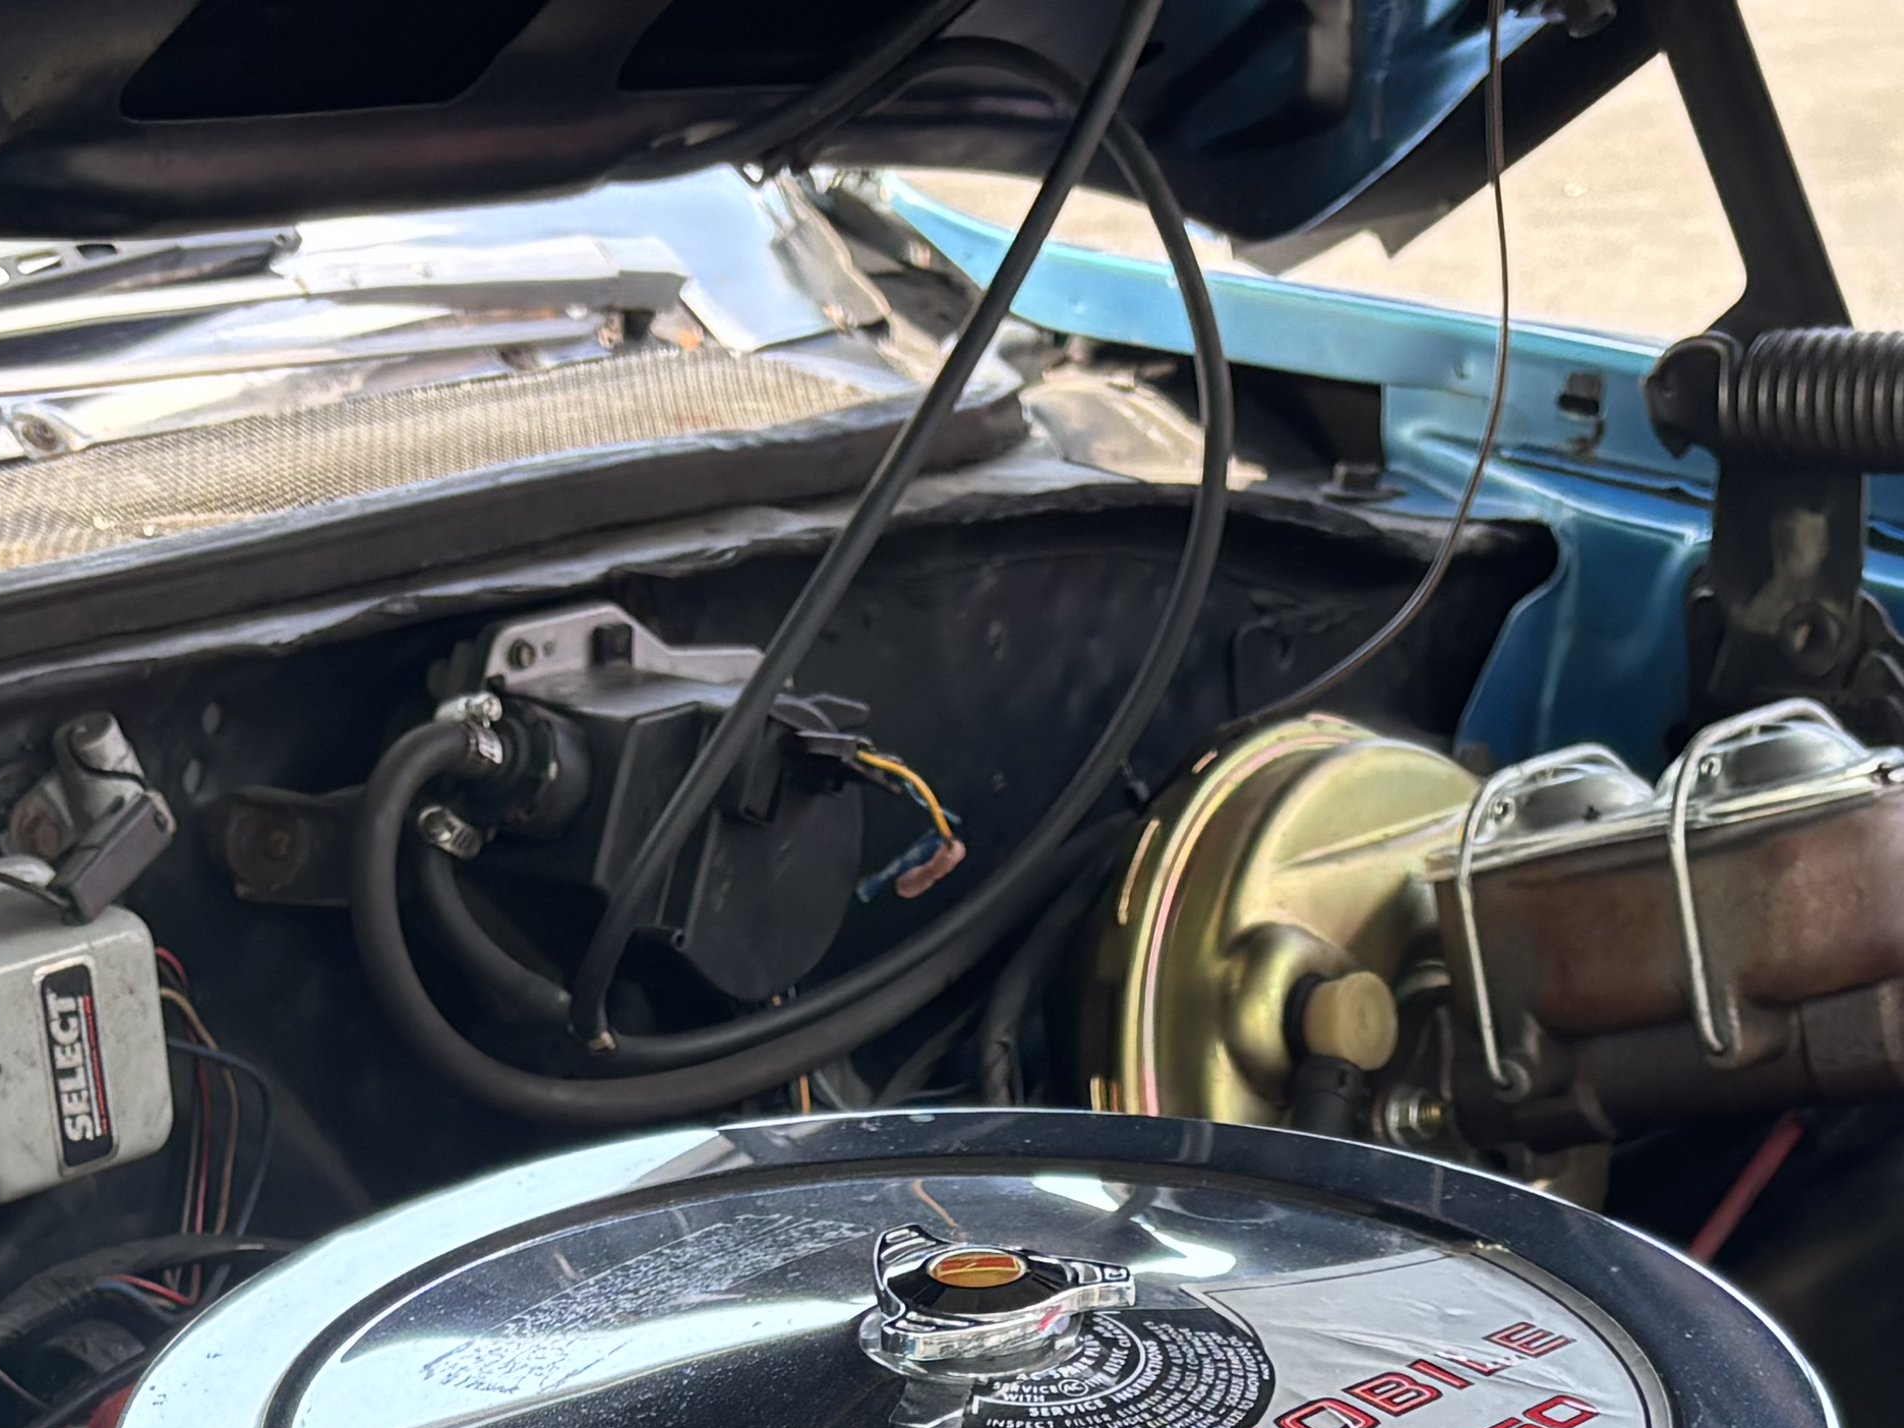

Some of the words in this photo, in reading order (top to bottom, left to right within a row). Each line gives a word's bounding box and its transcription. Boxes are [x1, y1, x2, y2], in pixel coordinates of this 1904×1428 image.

[45, 986, 96, 1141] SELECT
[993, 1382, 1060, 1395] SERVICE
[1028, 1400, 1107, 1418] SERVICE
[1110, 1339, 1165, 1404] INSTRUCTIONS
[1003, 1392, 1045, 1403] WITH
[1065, 1413, 1113, 1428] FILTER
[1116, 1389, 1168, 1420] ELEMENT
[1200, 1379, 1226, 1411] ELEMENT
[1147, 1401, 1194, 1428] ELEMENT
